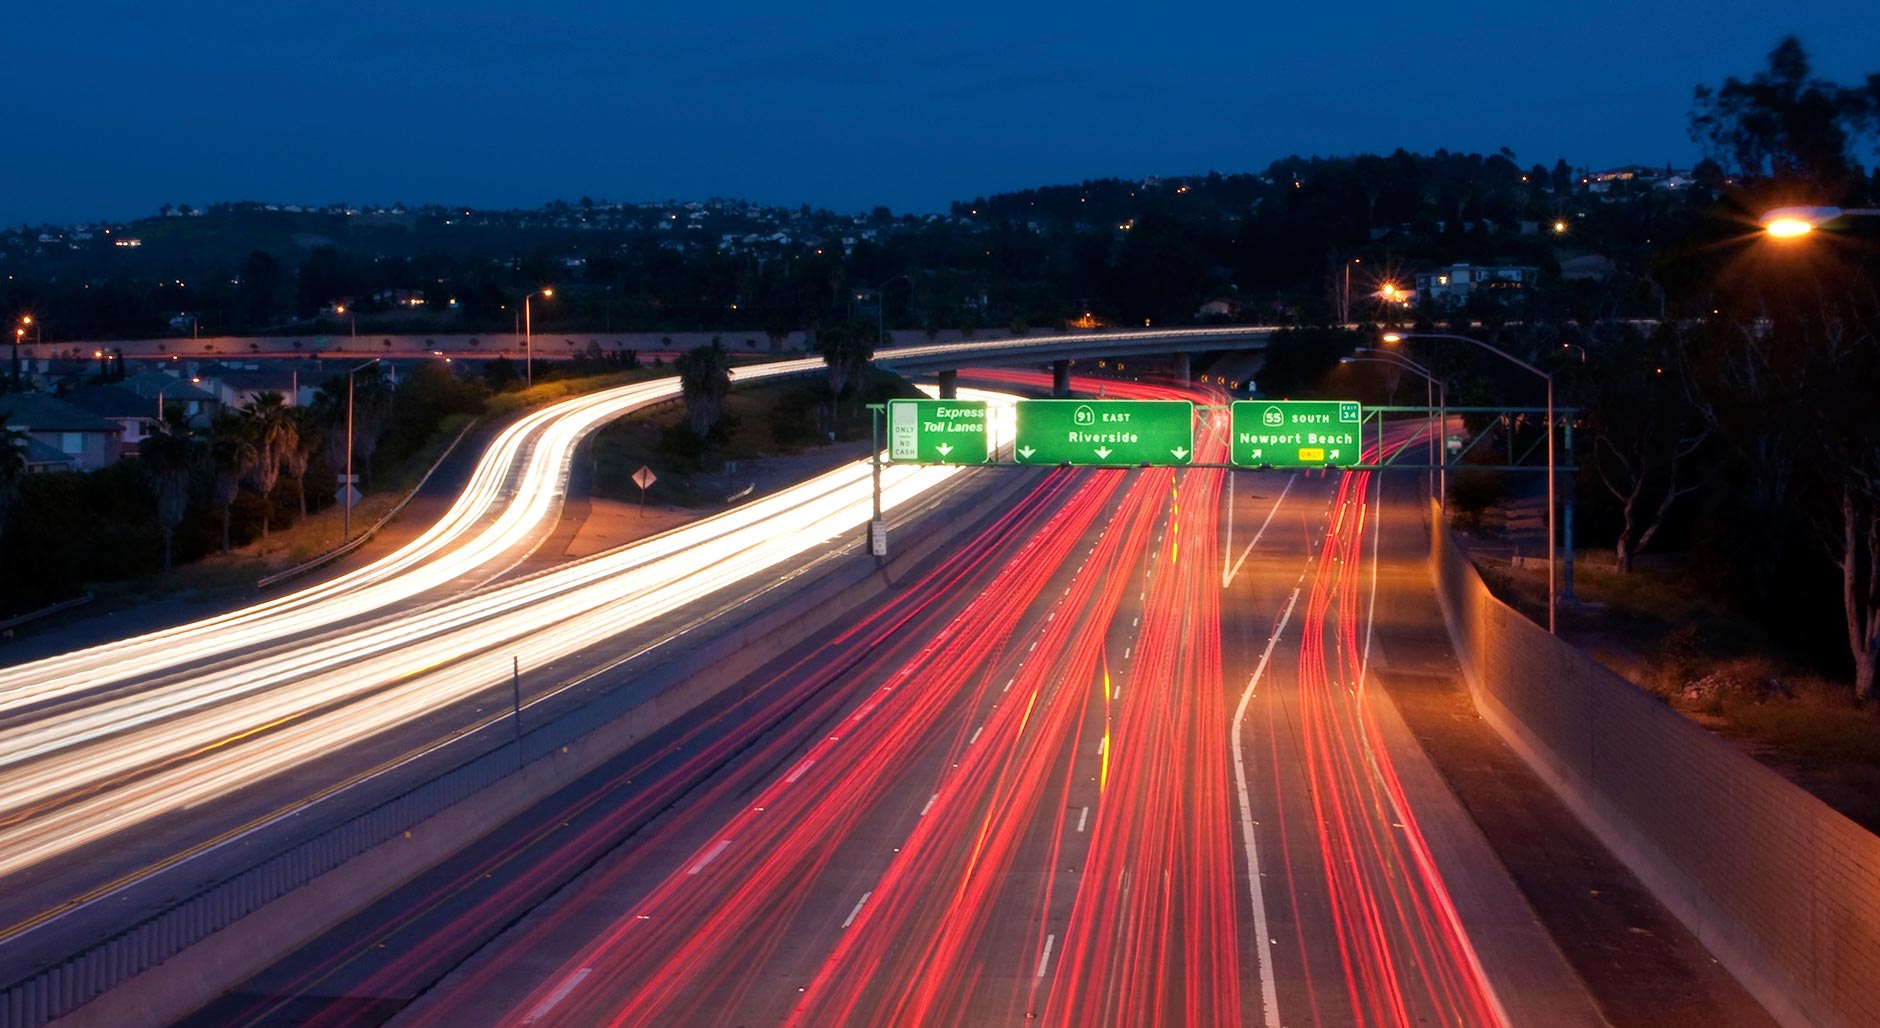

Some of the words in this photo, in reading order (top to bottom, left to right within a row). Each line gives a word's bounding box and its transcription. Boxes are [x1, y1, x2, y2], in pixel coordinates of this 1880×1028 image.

[936, 407, 985, 419] Express
[1077, 411, 1092, 422] 91
[1102, 413, 1130, 422] EAST
[1265, 413, 1281, 423] 55
[1291, 414, 1330, 423] SOUTH
[1343, 411, 1356, 419] 34
[923, 422, 945, 432] Toll
[947, 422, 983, 432] Lanes
[1068, 431, 1138, 443] Riverside
[1240, 433, 1301, 445] Newport
[1308, 433, 1352, 444] Beach
